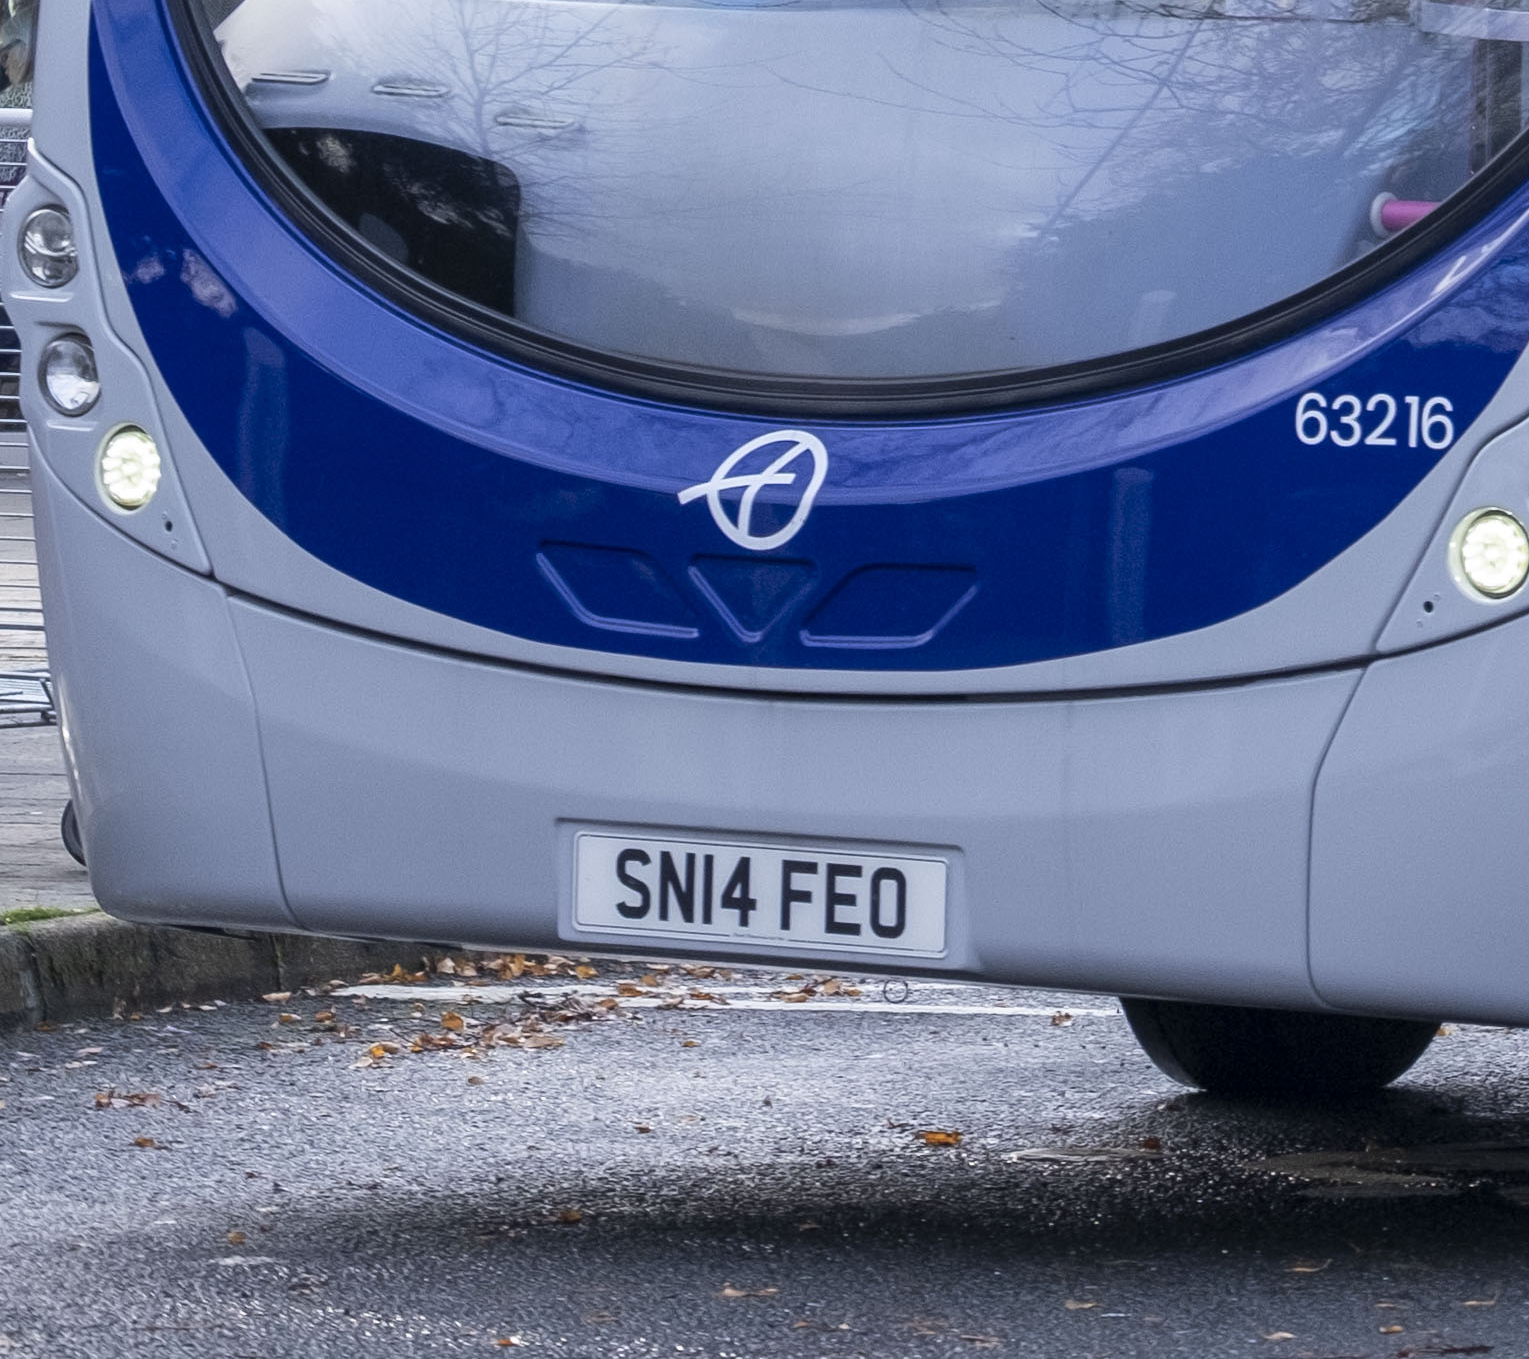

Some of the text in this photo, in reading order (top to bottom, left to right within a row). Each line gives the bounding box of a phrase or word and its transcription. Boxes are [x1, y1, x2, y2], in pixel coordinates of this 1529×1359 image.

[1294, 392, 1456, 450] 63216
[615, 847, 907, 940] SN14 FEO
